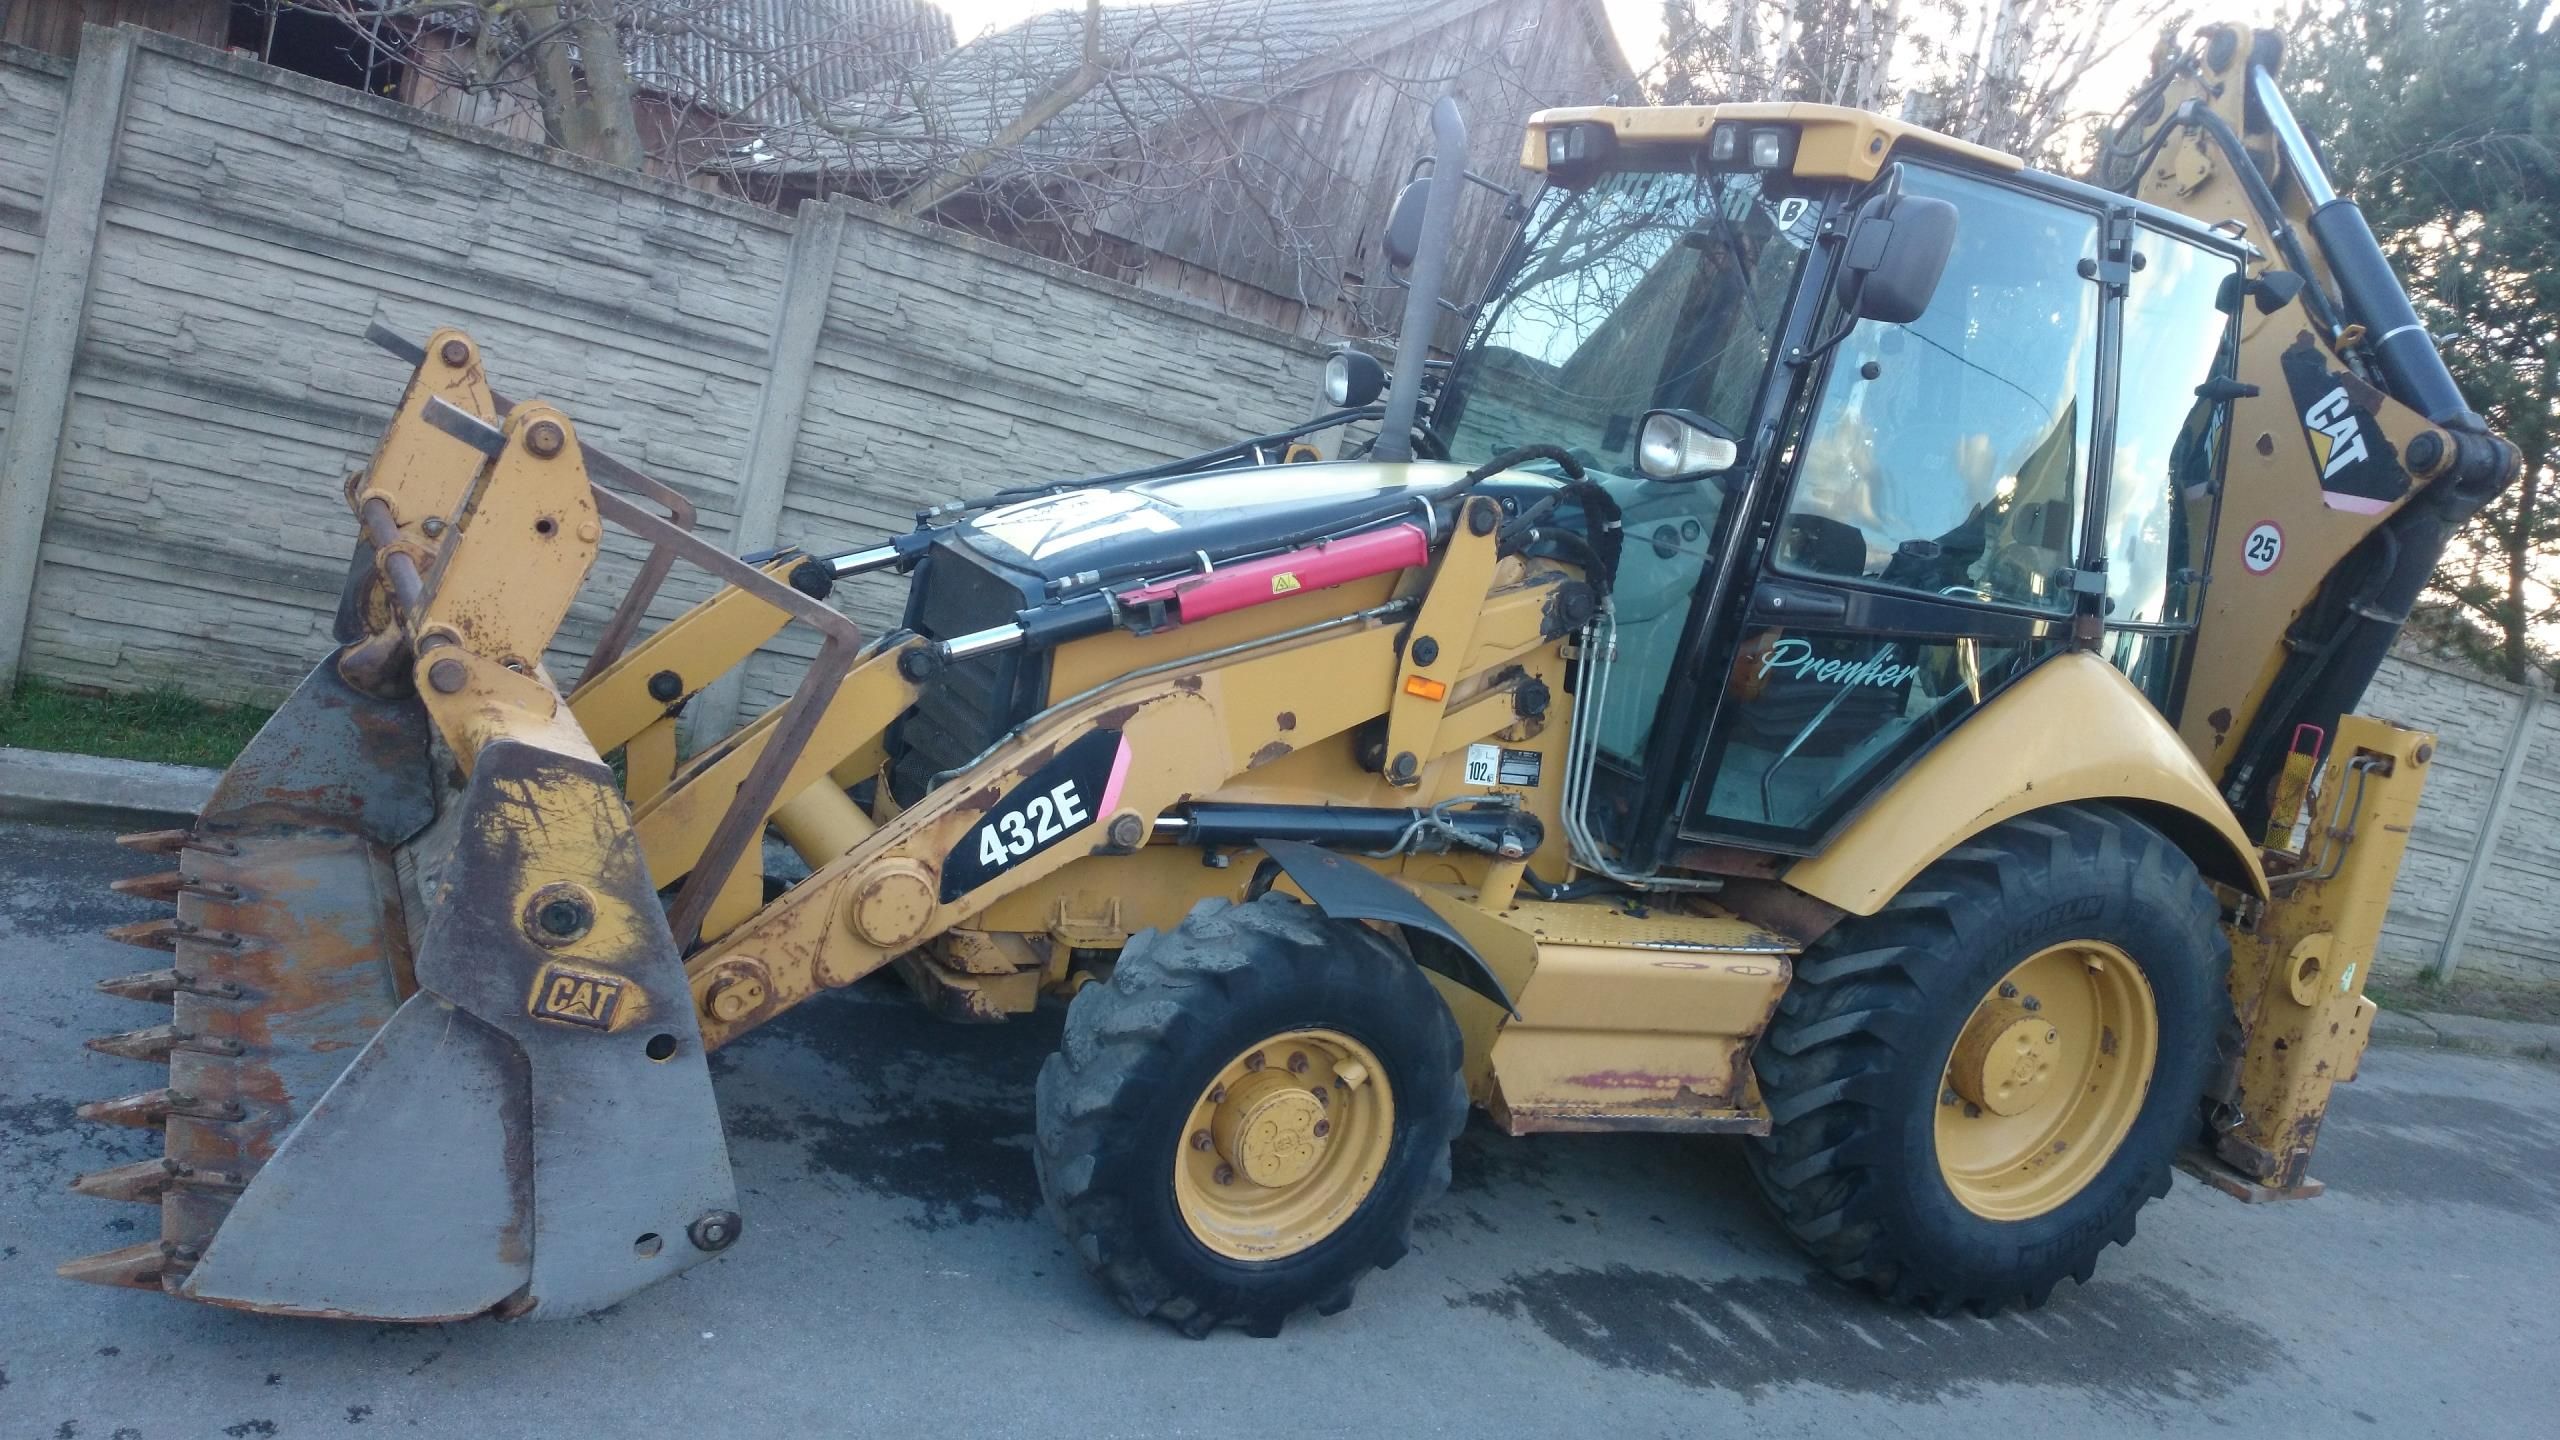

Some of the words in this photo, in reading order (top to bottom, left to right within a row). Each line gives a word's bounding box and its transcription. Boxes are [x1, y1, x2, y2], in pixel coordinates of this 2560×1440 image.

[1781, 200, 1802, 222] B
[2305, 386, 2369, 480] CAT
[2247, 533, 2278, 563] 25
[1757, 638, 1920, 688] Premier
[1469, 760, 1489, 782] 102
[979, 778, 1089, 867] 432E
[545, 976, 617, 1022] CAT
